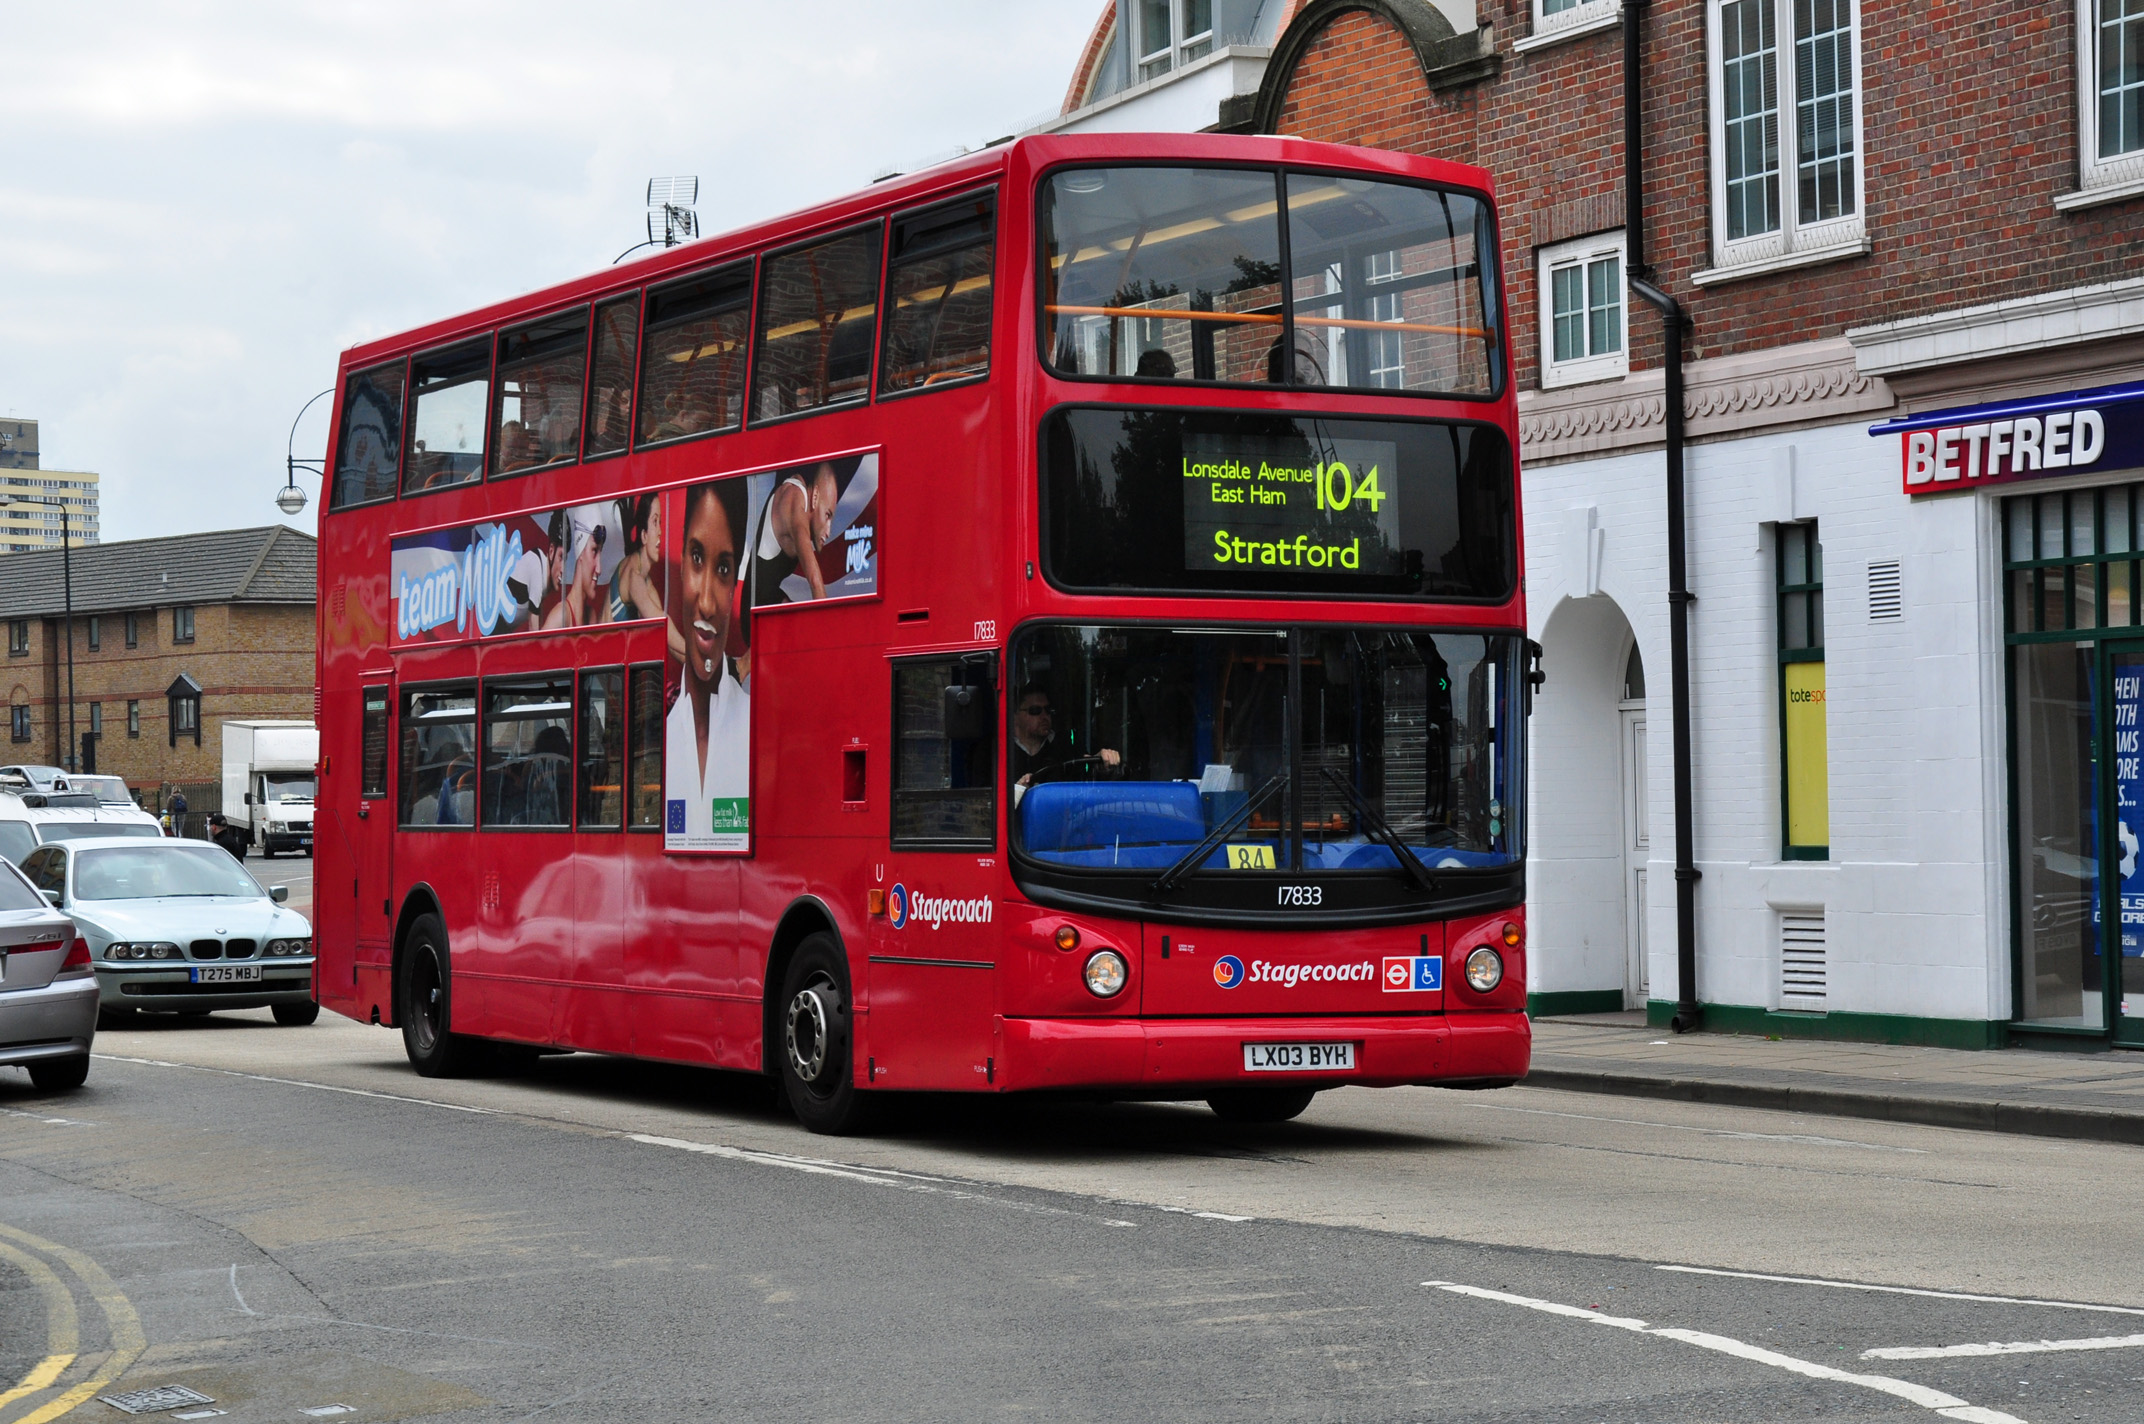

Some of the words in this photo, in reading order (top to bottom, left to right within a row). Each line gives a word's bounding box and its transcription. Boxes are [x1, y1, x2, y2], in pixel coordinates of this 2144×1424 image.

[1906, 409, 2106, 486] BETFRED
[1183, 457, 1251, 480] Lonsdale
[1258, 461, 1313, 483] Avenue
[1211, 483, 1244, 504] East
[1250, 485, 1286, 505] Ham
[1316, 461, 1386, 512] 104
[1214, 530, 1359, 569] Stratford
[398, 572, 457, 638] team
[459, 525, 522, 634] Milk
[974, 620, 996, 640] 17833
[1790, 688, 1826, 704] totespo
[2115, 677, 2139, 699] HEN
[2115, 704, 2138, 726] OTH
[2116, 731, 2139, 753] AMS
[2117, 758, 2139, 780] ORE
[1238, 848, 1266, 870] 84
[876, 864, 884, 882] U
[1278, 886, 1322, 905] 17833
[910, 890, 993, 931] Stagecoach
[200, 968, 232, 981] T275
[235, 967, 260, 980] MBJ
[1249, 960, 1374, 988] Stagecoach
[1251, 1046, 1303, 1067] LX03
[1309, 1045, 1346, 1066] BYH
